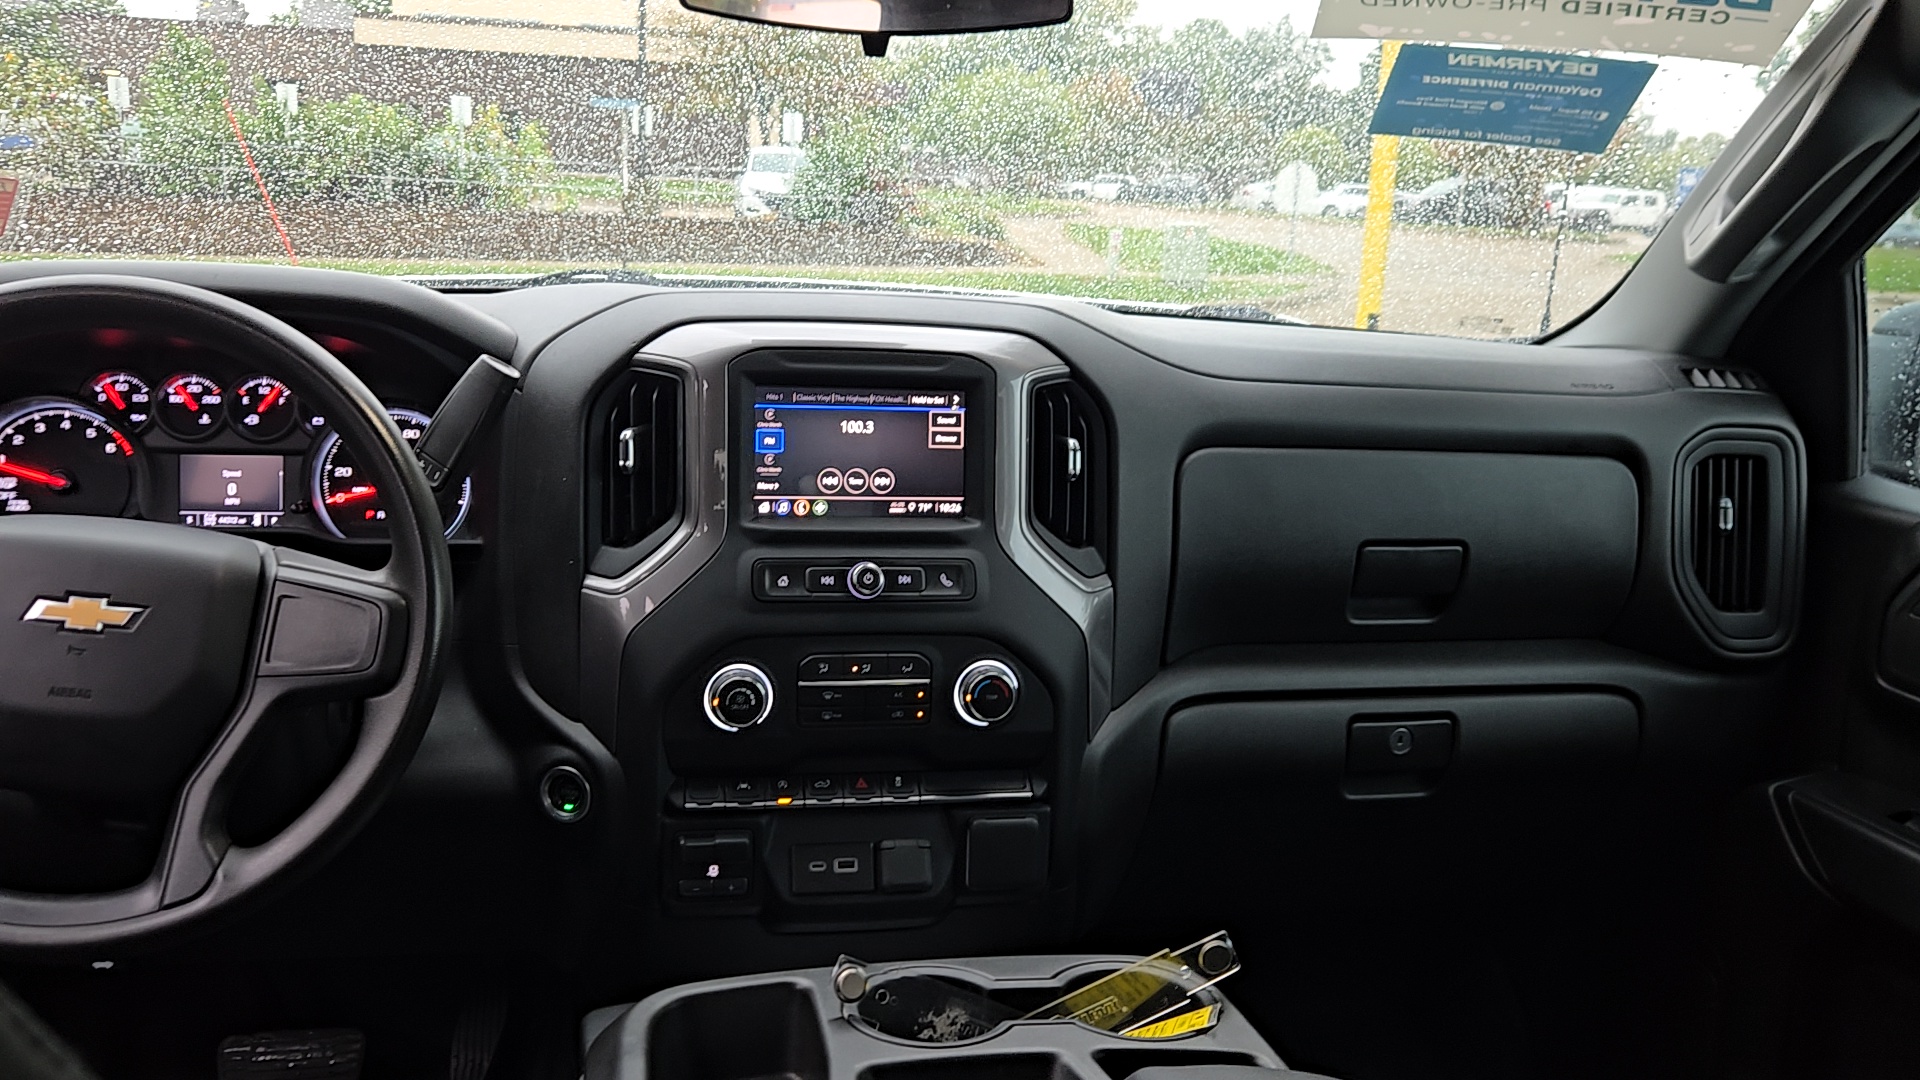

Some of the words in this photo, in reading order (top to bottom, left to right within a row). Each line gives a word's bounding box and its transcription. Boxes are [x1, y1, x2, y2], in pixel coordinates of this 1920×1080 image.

[97, 392, 107, 402] 0
[241, 396, 250, 405] E
[278, 397, 287, 406] F
[796, 393, 817, 402] Classic
[911, 395, 926, 404] Hold
[34, 422, 47, 434] 3
[60, 419, 72, 431] 4
[840, 419, 875, 435] 100.3
[85, 427, 98, 439] 5
[12, 434, 25, 445] 2
[104, 442, 118, 454] 6
[333, 466, 353, 478] 20
[226, 482, 238, 496] 0
